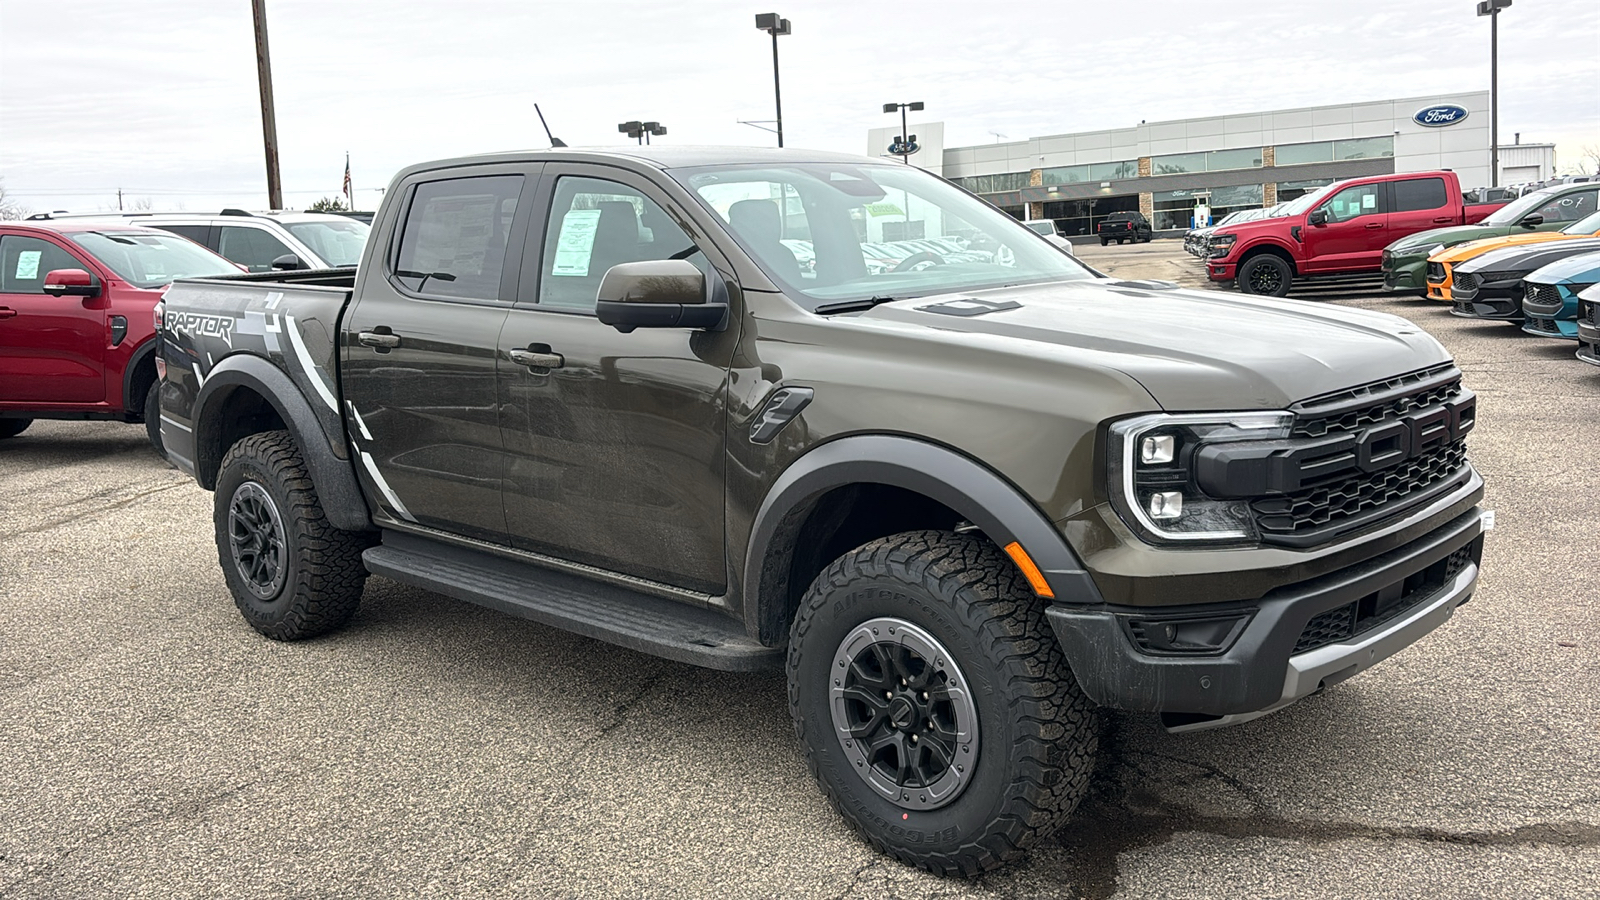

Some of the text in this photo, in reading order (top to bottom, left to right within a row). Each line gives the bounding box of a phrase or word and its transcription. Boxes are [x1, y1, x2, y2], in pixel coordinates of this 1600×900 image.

[1424, 108, 1457, 123] Ford
[165, 310, 235, 350] RAPTOR
[1266, 387, 1477, 494] FORD
[832, 586, 962, 641] All-Terrain
